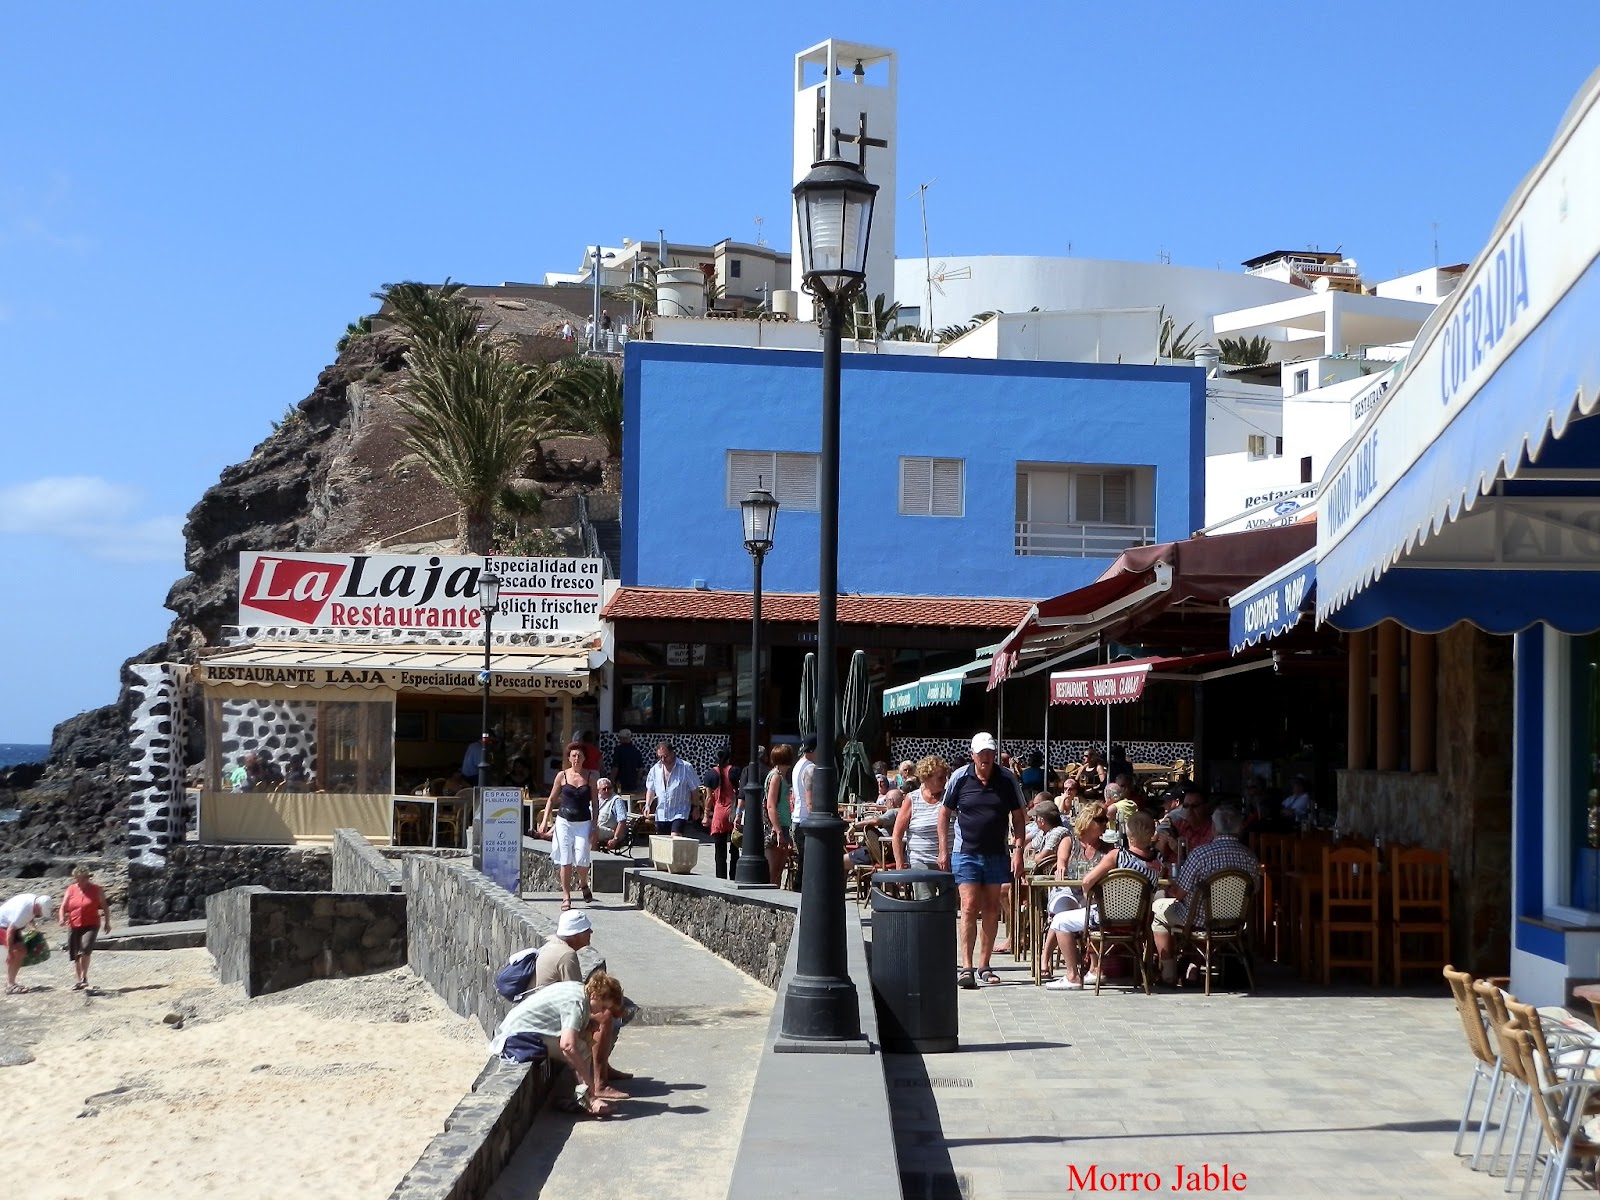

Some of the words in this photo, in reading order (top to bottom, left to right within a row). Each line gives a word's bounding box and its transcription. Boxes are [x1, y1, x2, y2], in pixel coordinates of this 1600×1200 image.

[1441, 221, 1529, 406] COFRADIA
[1328, 465, 1350, 537] MORRO
[1355, 429, 1378, 509] JABLE
[484, 557, 576, 575] Especialidad
[581, 562, 598, 574] en
[250, 560, 331, 602] La
[339, 556, 481, 606] Laja
[498, 575, 546, 588] escado
[551, 575, 594, 589] fresco
[331, 603, 481, 628] Restaurante
[541, 599, 598, 613] frischer
[1244, 590, 1279, 634] BOUTIQUE
[521, 615, 559, 630] Fisch
[207, 666, 315, 682] RESTAURANTE
[325, 670, 386, 683] LAJA
[401, 671, 475, 687] Especialidad
[495, 674, 541, 688] Pescado
[544, 676, 582, 689] Fresco
